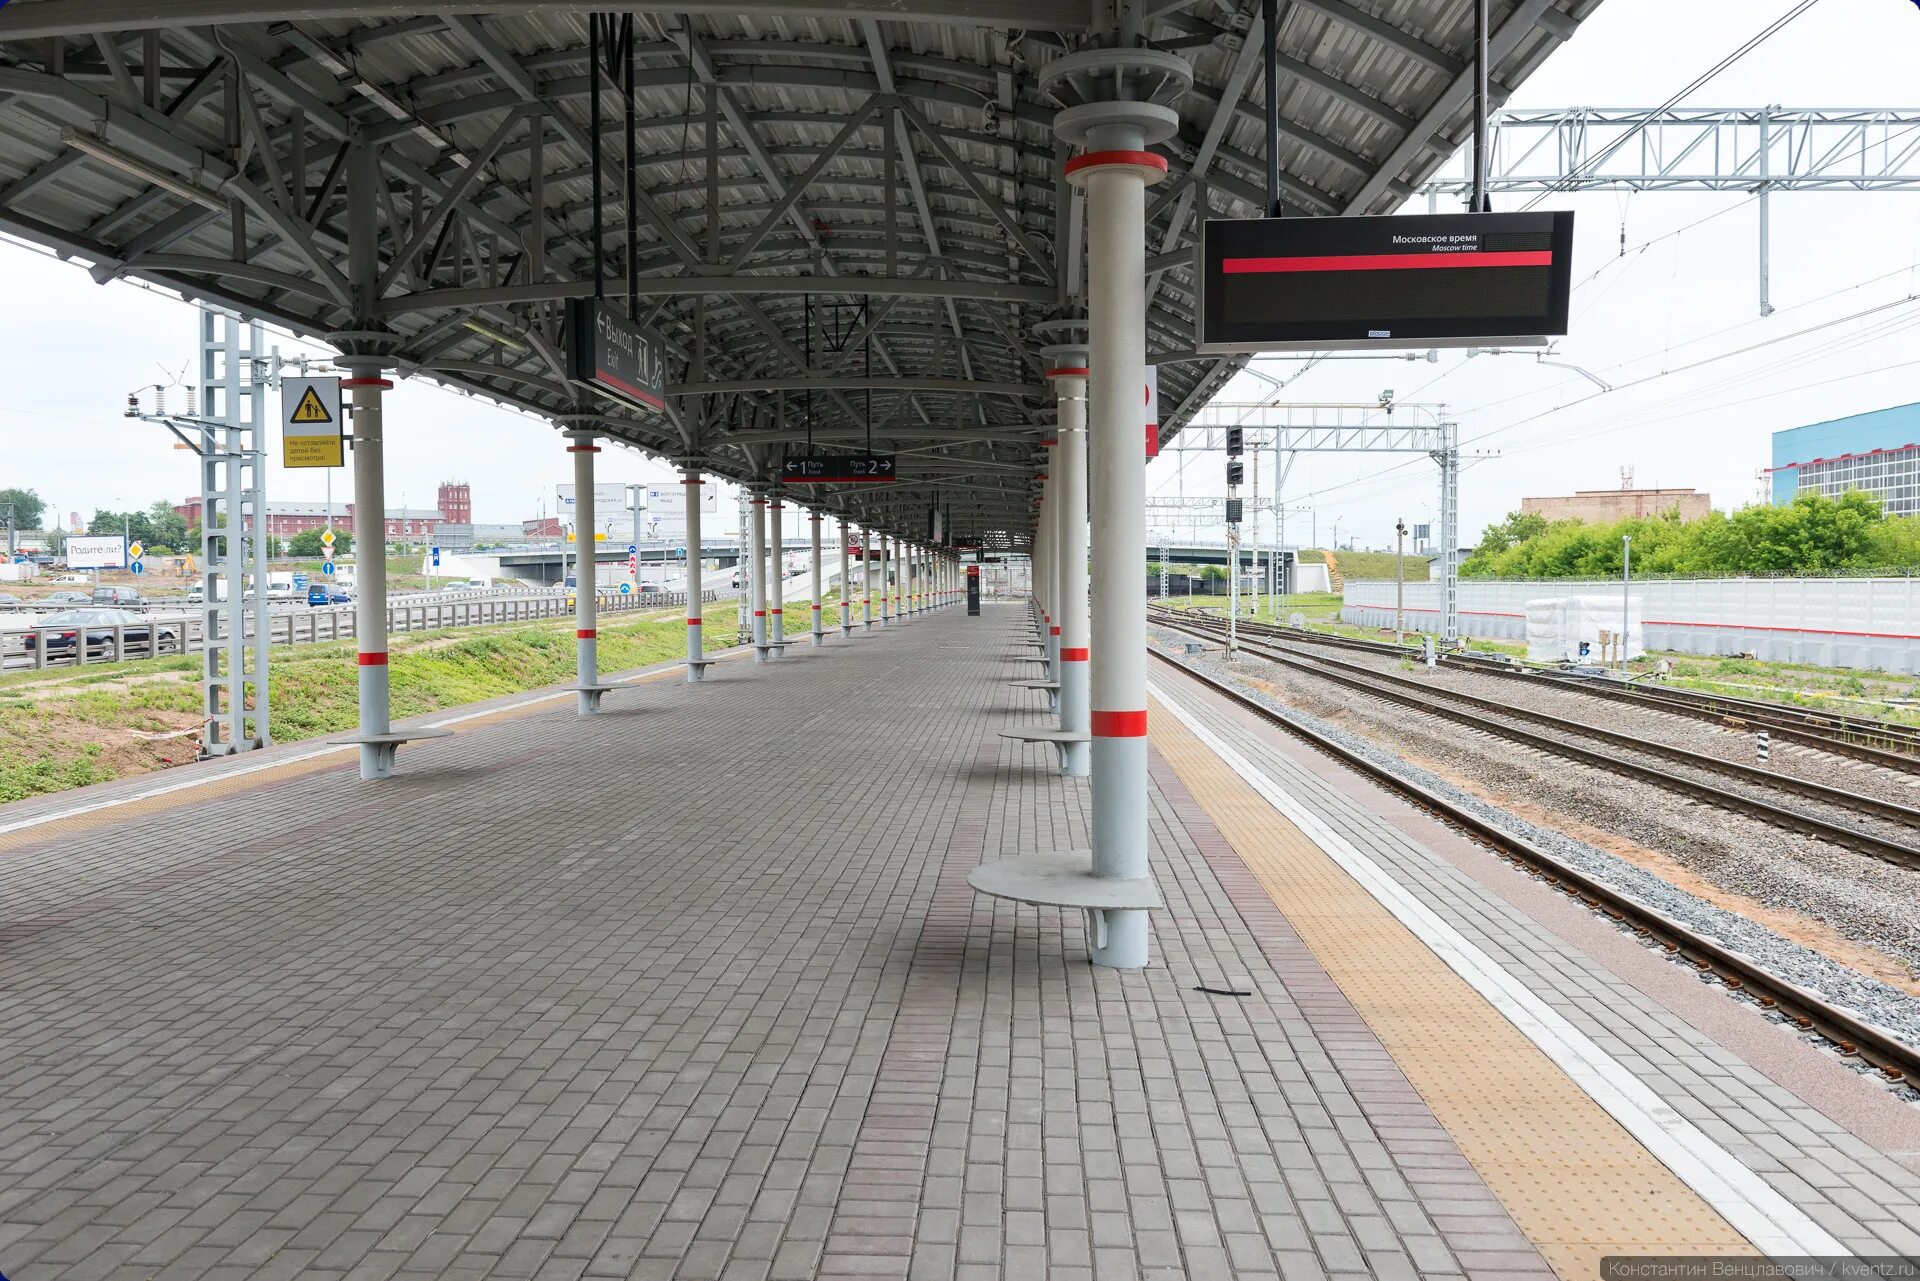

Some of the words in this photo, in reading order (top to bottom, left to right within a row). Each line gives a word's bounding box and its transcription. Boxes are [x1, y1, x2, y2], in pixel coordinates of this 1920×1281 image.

[1392, 235, 1448, 244] Московское
[1449, 234, 1477, 243] время
[1432, 244, 1461, 252] Moscow
[606, 315, 633, 358] Выход
[607, 348, 619, 370] Exit
[800, 461, 806, 475] 1
[868, 460, 877, 474] 2
